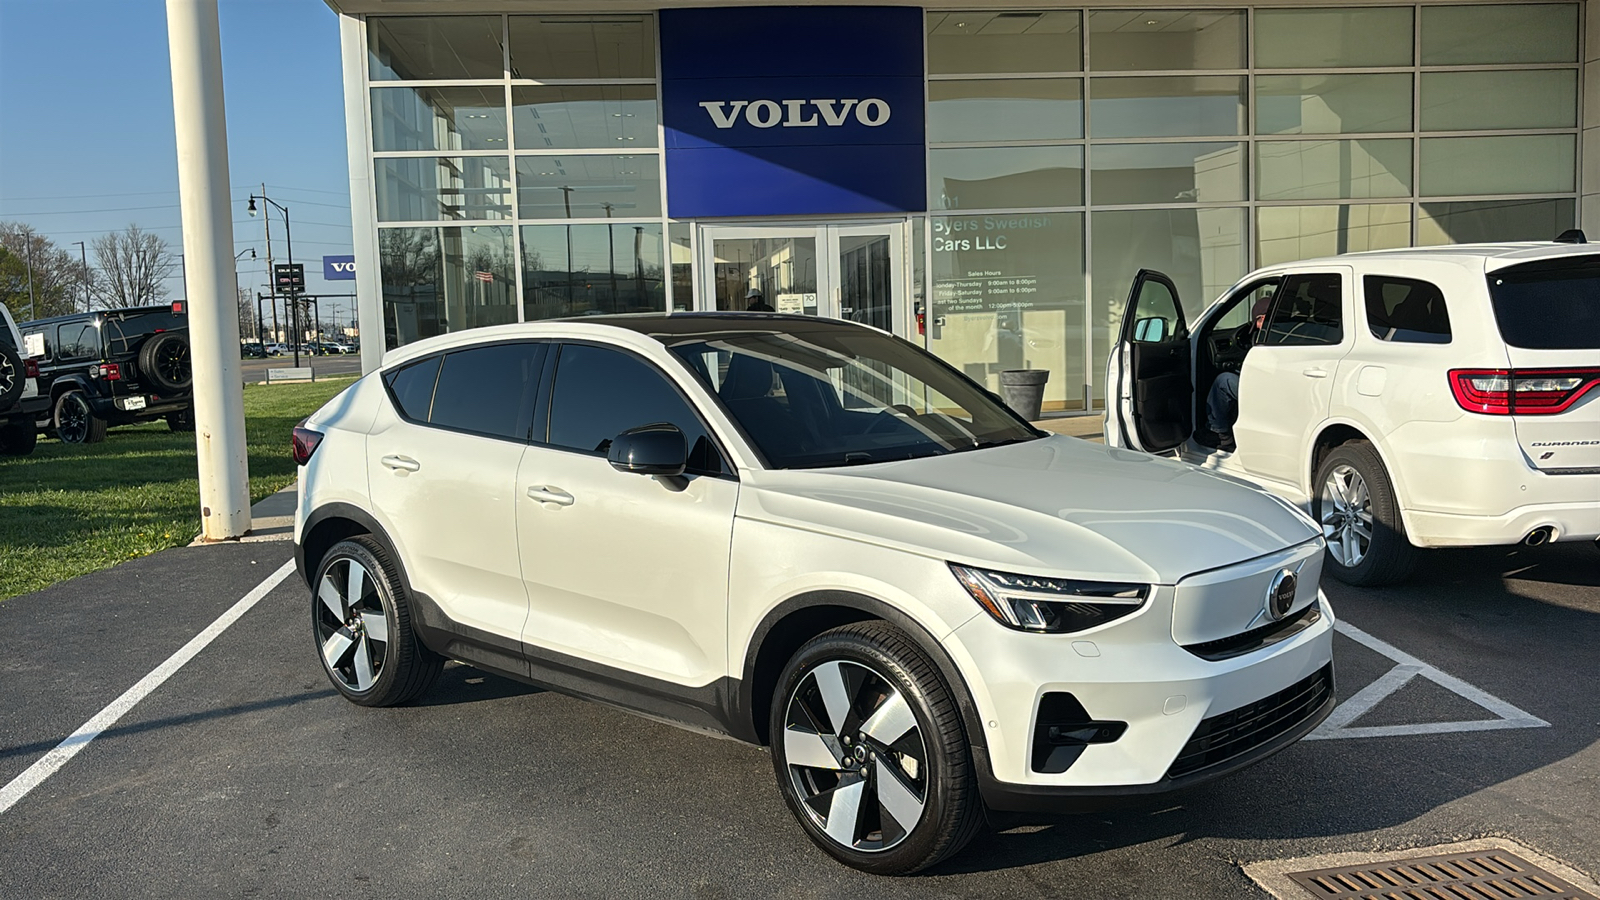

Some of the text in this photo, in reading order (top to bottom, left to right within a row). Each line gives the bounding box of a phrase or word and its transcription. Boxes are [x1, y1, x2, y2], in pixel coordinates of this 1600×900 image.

[699, 98, 891, 128] VOLVO
[934, 215, 1052, 235] Byers Swedish
[933, 235, 1007, 251] Cars LLC
[805, 294, 815, 302] 70
[938, 289, 982, 297] Friday-Saturday
[882, 658, 914, 690] ZERO
